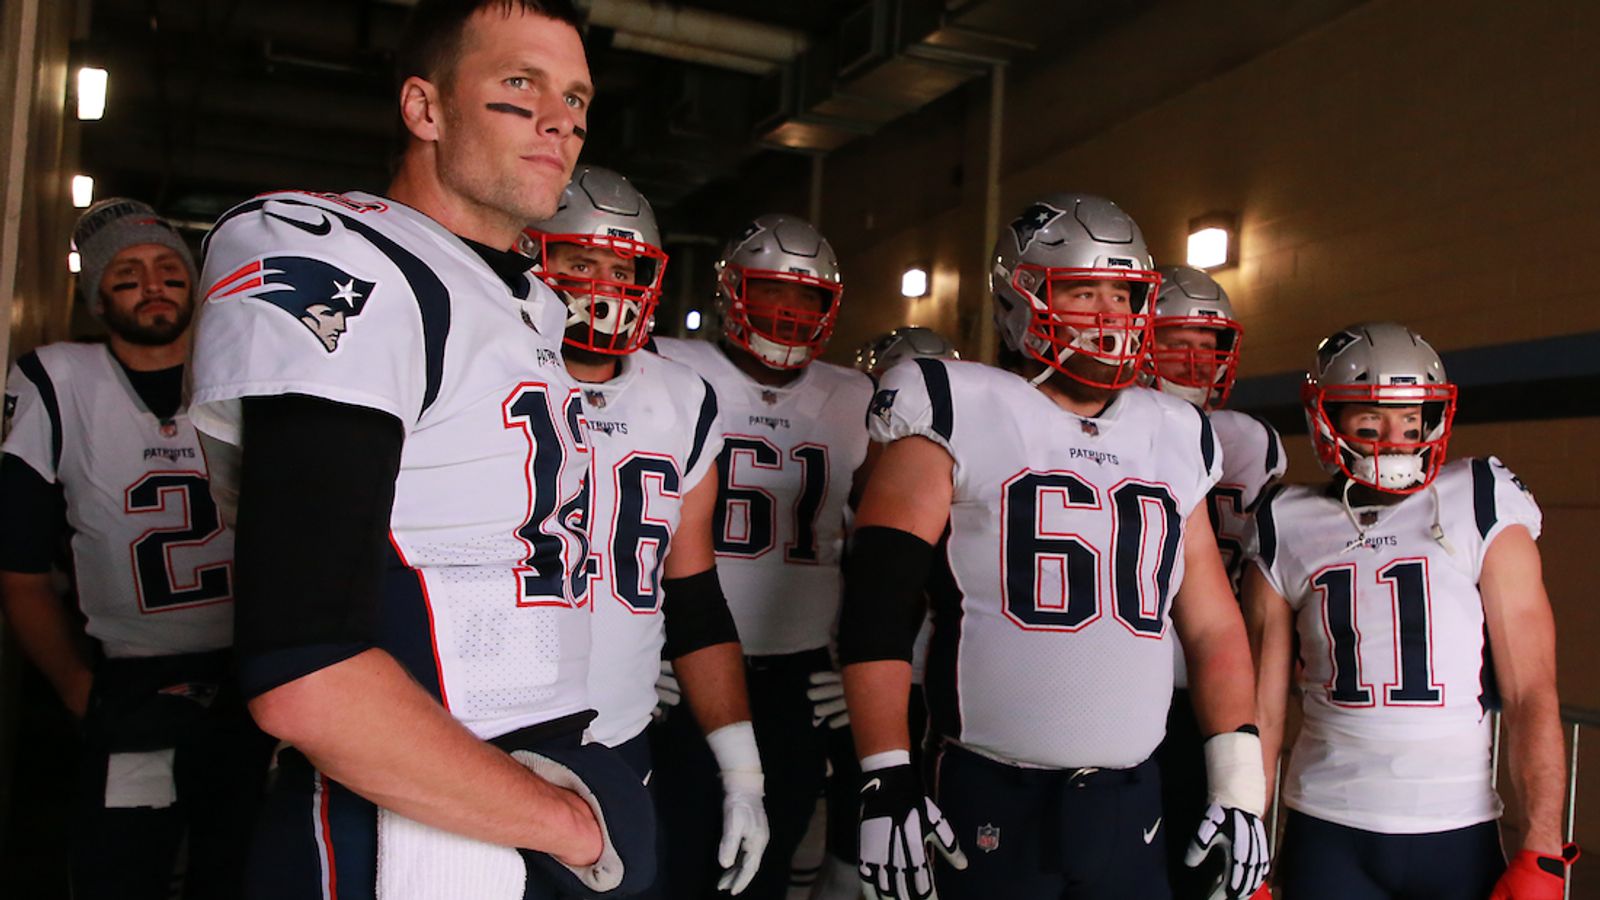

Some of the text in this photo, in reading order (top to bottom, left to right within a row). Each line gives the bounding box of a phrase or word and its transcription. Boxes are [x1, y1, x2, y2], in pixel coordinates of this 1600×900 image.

[143, 448, 196, 460] PATRIOTS
[586, 420, 628, 434] TRIOTS
[749, 415, 791, 429] PATRIOTS
[1069, 447, 1119, 465] PATRIOTS
[714, 433, 828, 564] 61
[124, 470, 235, 614] 2
[1001, 467, 1186, 638] 60
[1310, 556, 1445, 708] 11
